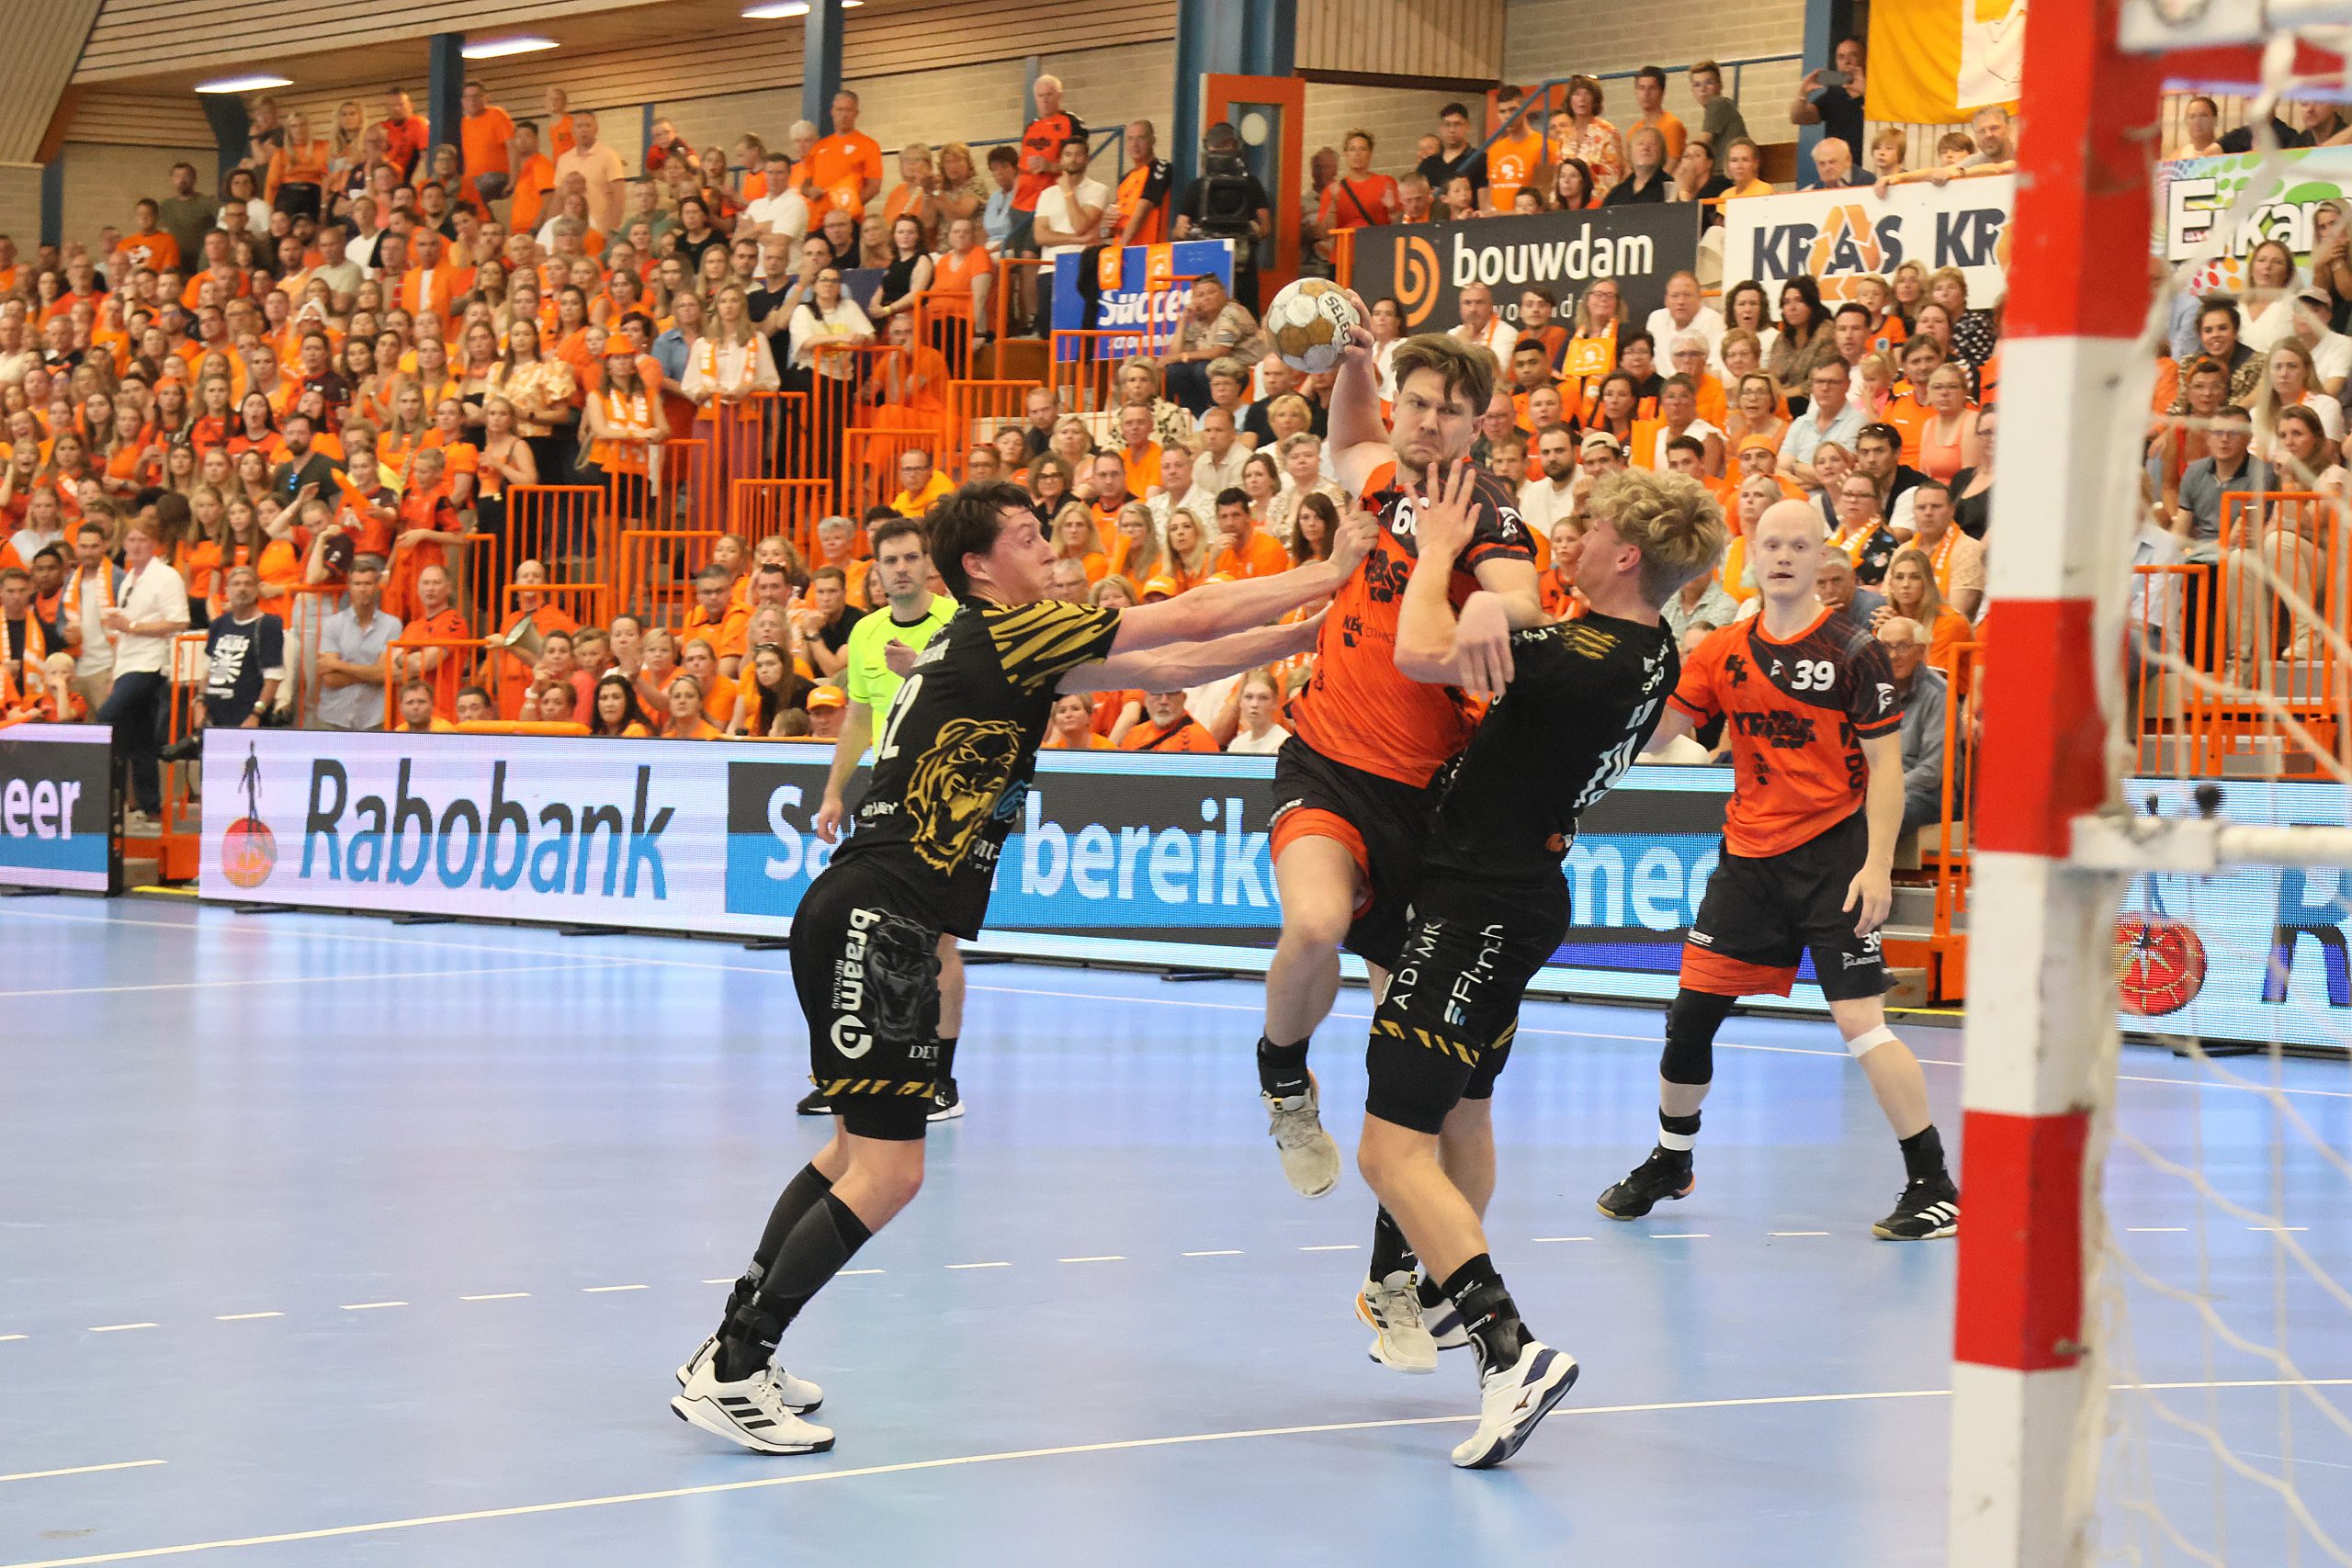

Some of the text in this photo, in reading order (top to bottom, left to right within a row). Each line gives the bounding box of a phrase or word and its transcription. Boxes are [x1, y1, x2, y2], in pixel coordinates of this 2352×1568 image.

[1453, 223, 1653, 288] bouwdam
[1753, 209, 2005, 281] KRAS KR
[1791, 659, 1837, 691] 39
[875, 673, 923, 763] 2
[0, 778, 81, 840] eer
[299, 757, 676, 900] Rabobank
[1022, 791, 1283, 908] bereik
[849, 908, 881, 1011] braam
